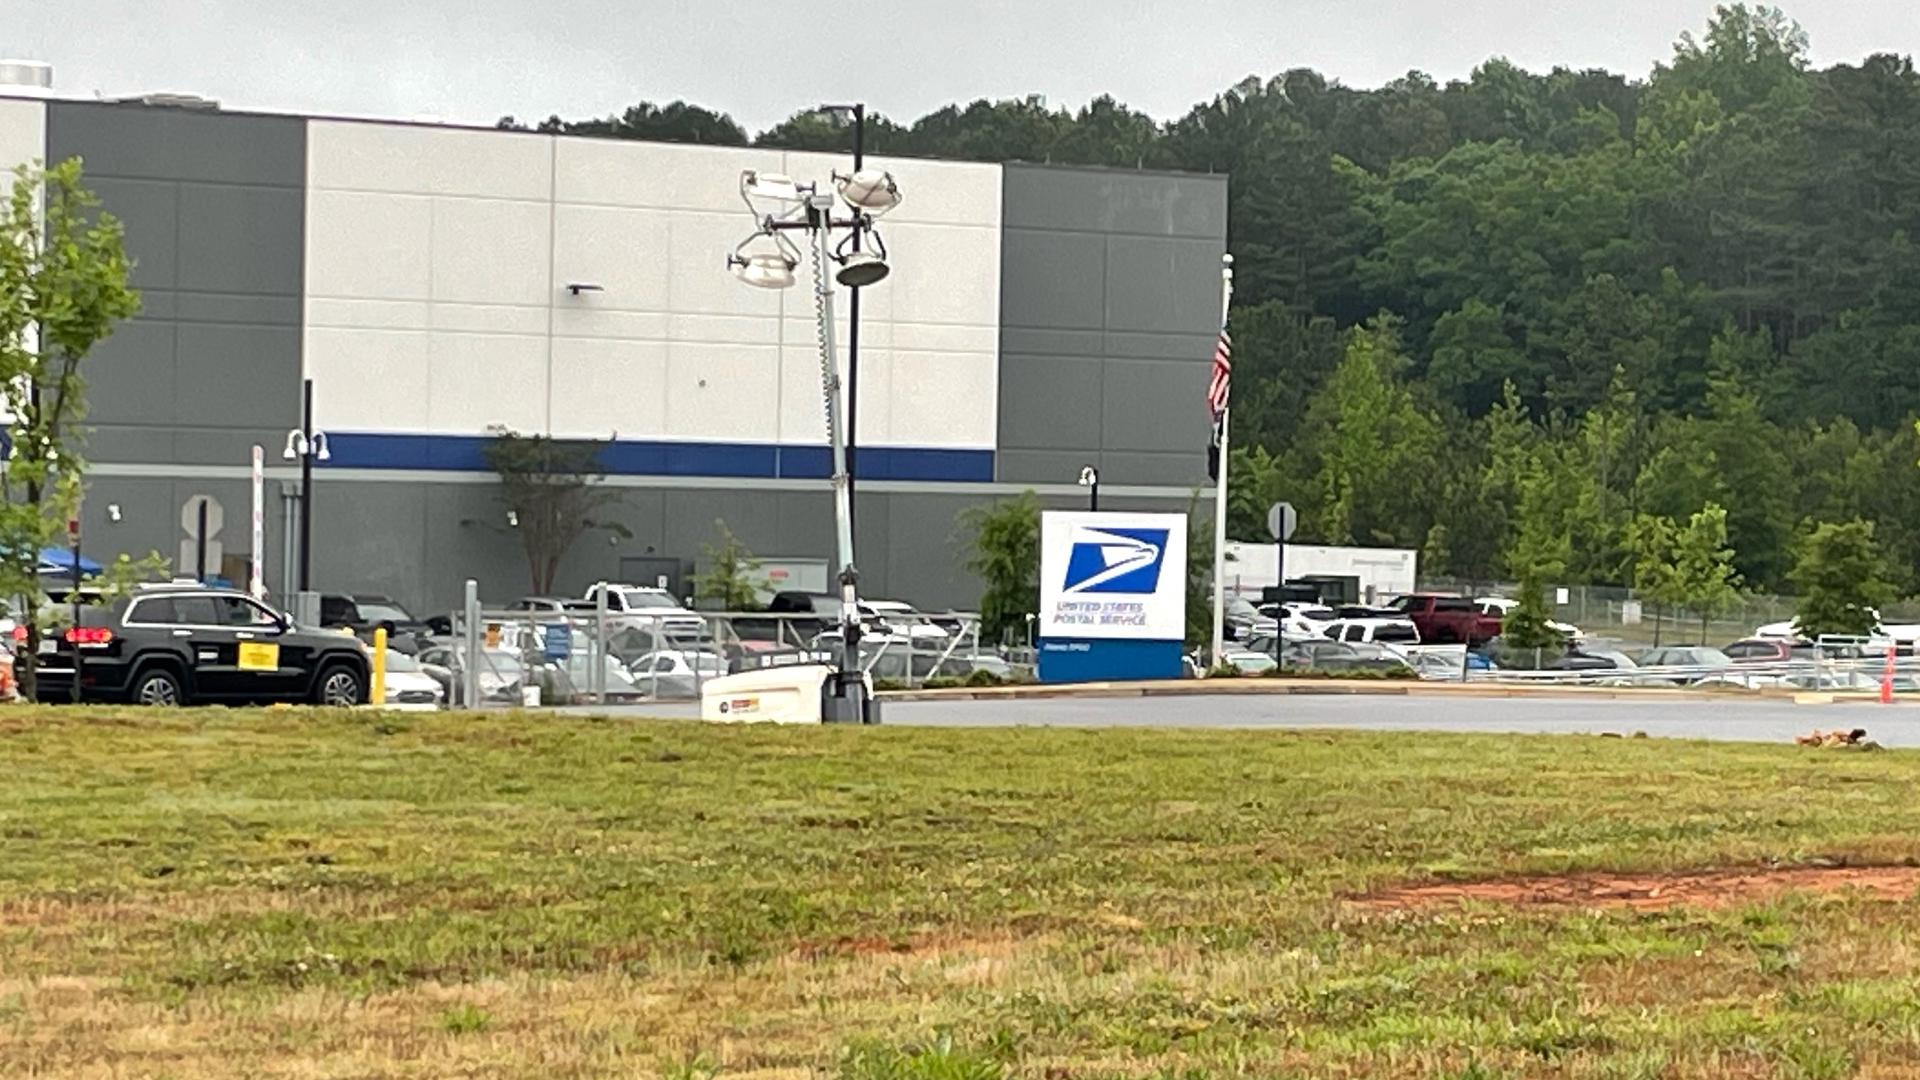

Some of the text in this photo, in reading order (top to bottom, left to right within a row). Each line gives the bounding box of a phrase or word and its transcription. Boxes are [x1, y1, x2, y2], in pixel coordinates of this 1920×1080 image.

[1057, 601, 1143, 612] UNITED STATES
[1053, 614, 1146, 625] POSTAL SERVICE
